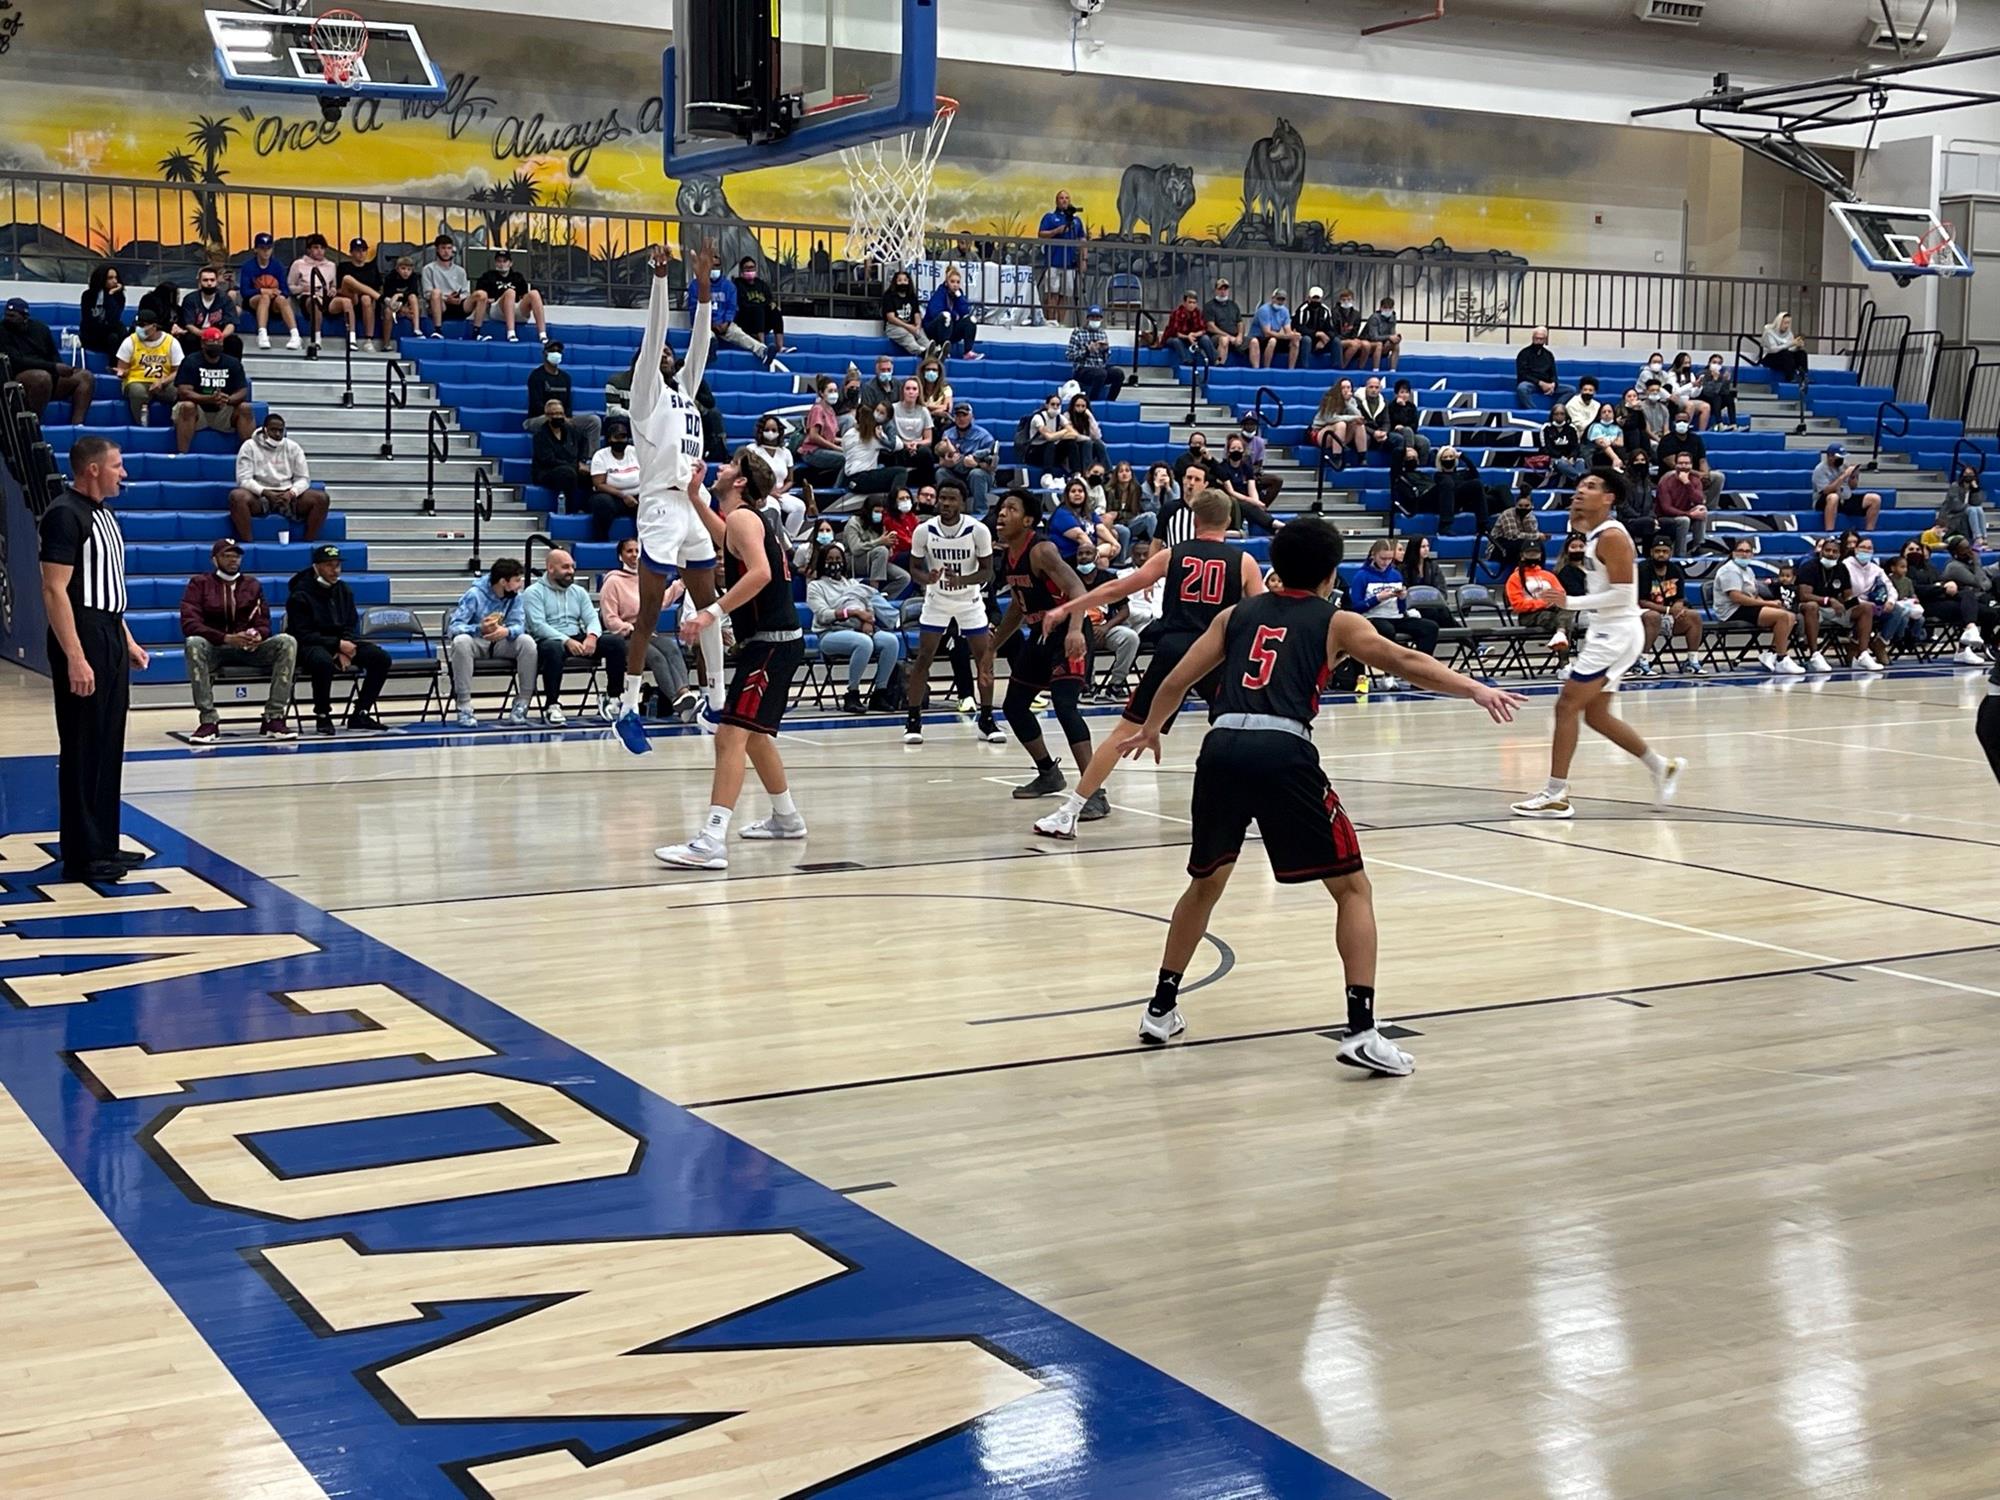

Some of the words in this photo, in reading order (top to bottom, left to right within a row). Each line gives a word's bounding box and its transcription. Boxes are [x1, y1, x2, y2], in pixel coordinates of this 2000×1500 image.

[144, 364, 163, 379] 23
[199, 367, 229, 379] THERE
[212, 378, 226, 388] NO
[1180, 556, 1226, 605] 20
[1242, 624, 1287, 690] 5
